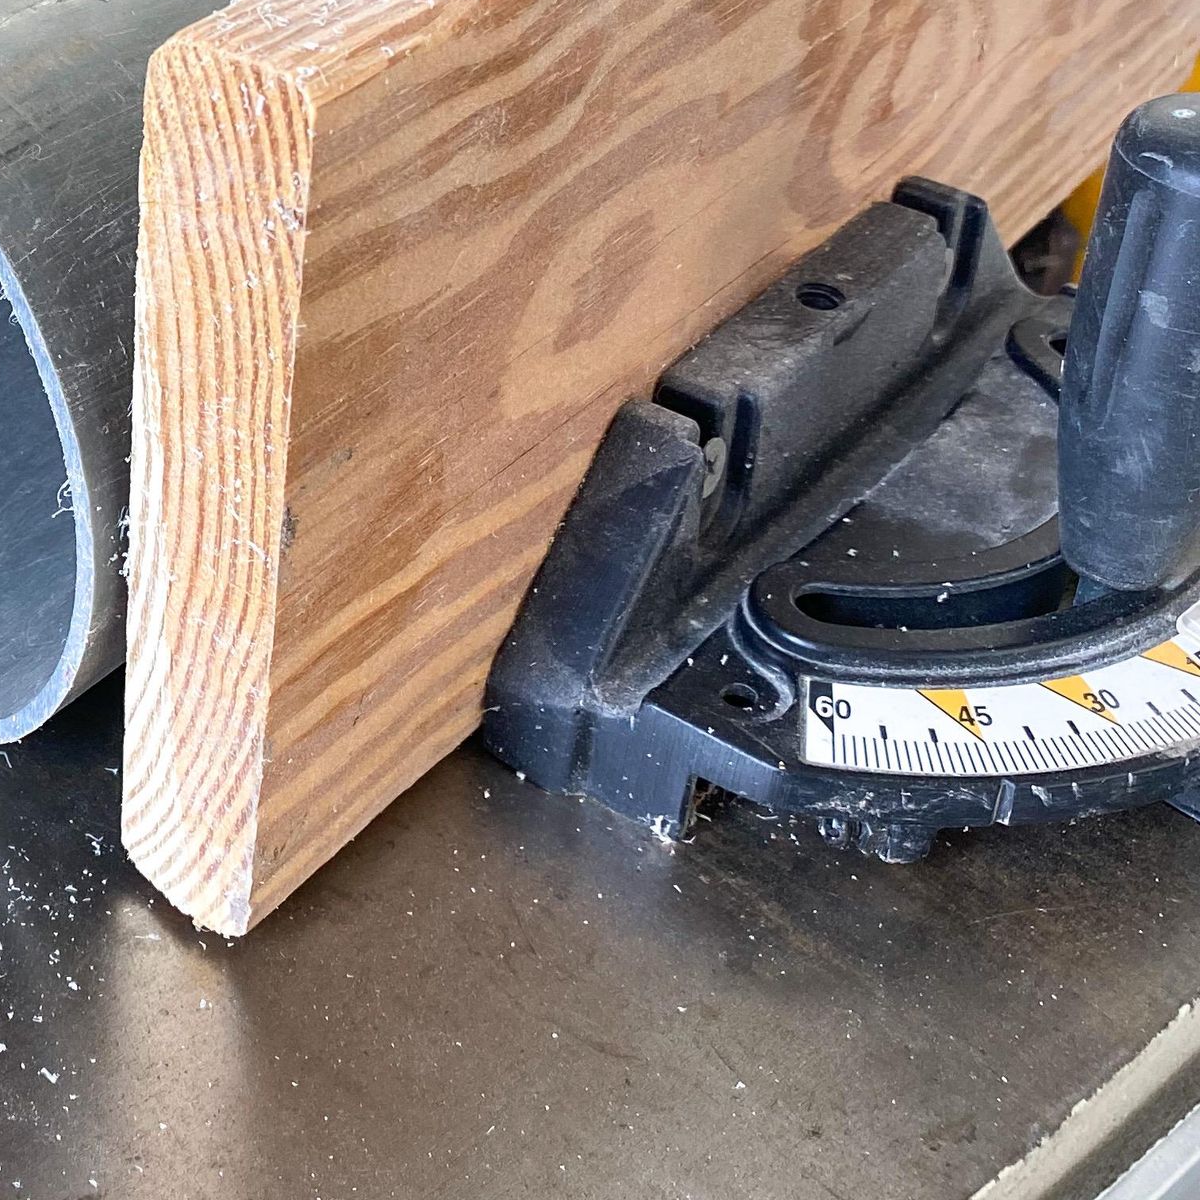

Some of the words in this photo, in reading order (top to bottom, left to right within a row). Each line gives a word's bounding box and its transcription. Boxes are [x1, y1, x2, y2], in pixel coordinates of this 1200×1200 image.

[814, 695, 852, 720] 60
[957, 705, 994, 728] 45
[1083, 688, 1121, 714] 30
